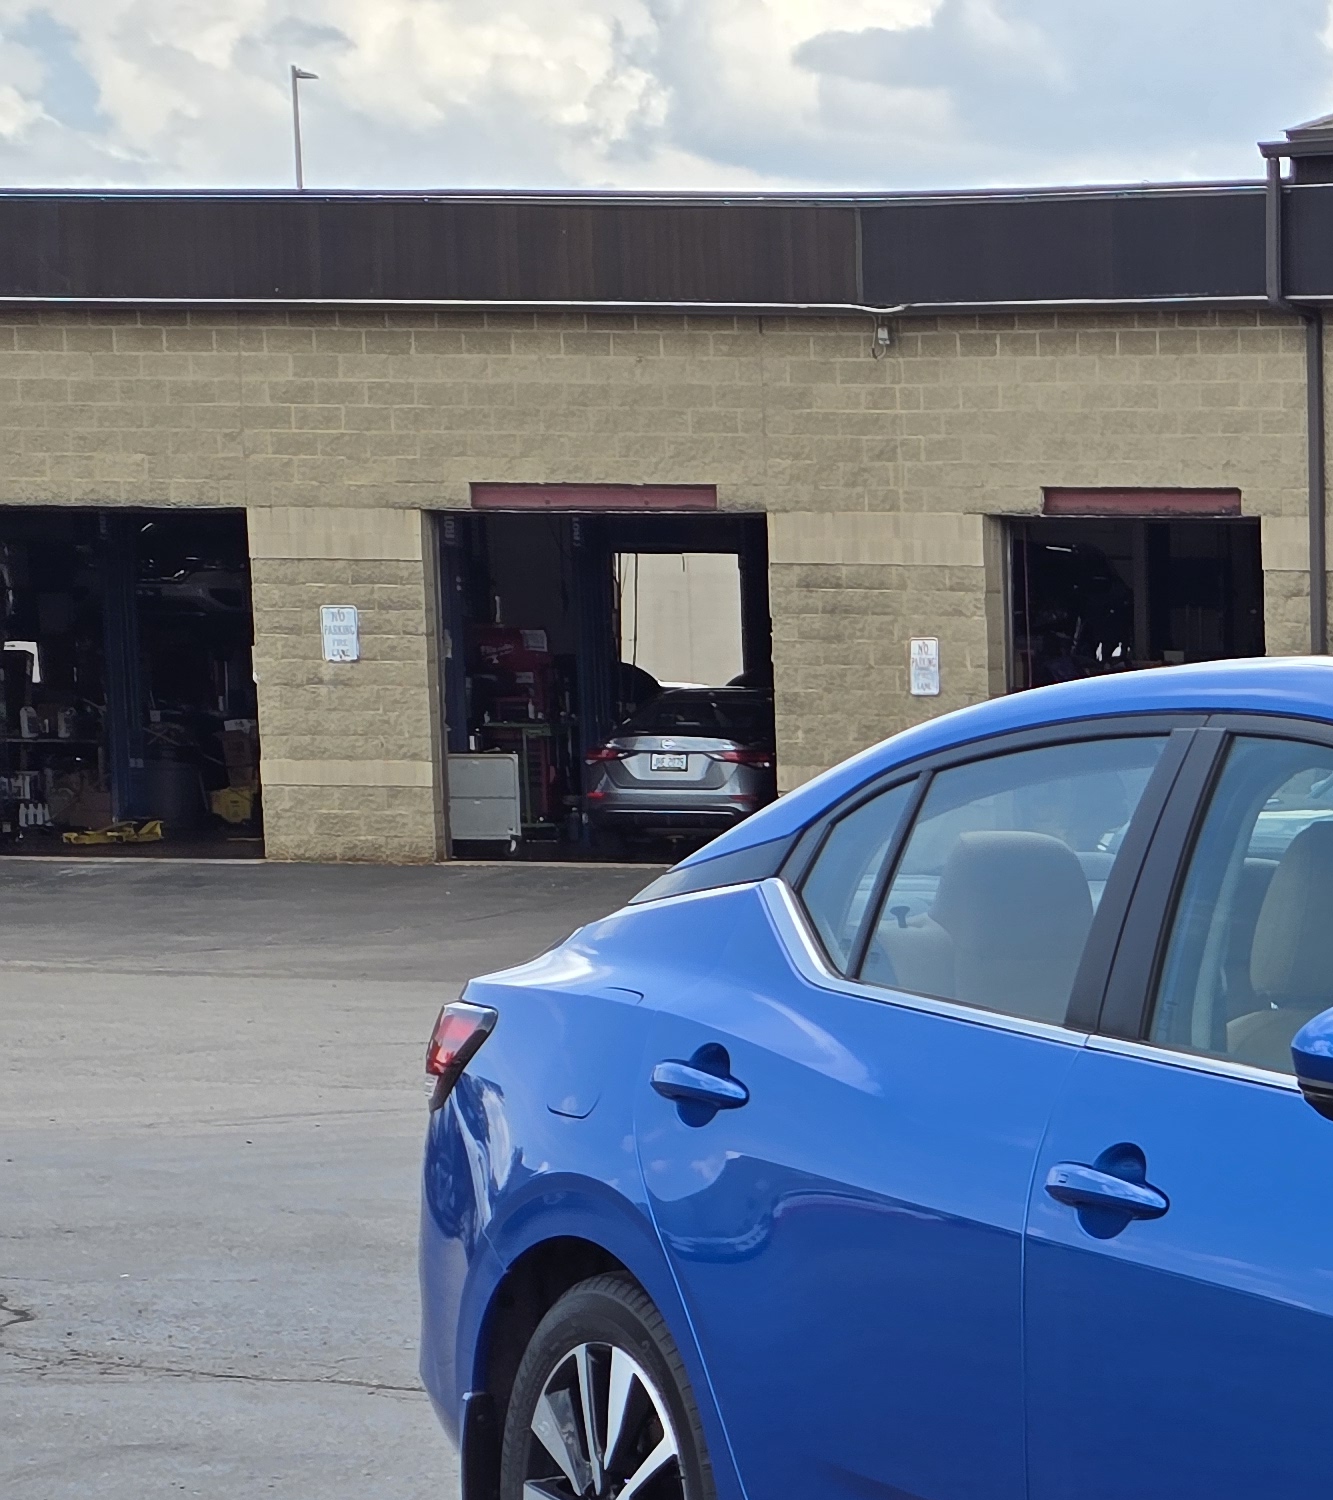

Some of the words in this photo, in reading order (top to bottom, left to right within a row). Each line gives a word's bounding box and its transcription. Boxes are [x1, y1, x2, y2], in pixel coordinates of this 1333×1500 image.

[331, 611, 345, 622] NO
[324, 625, 355, 635] PARKING
[918, 643, 929, 655] NO
